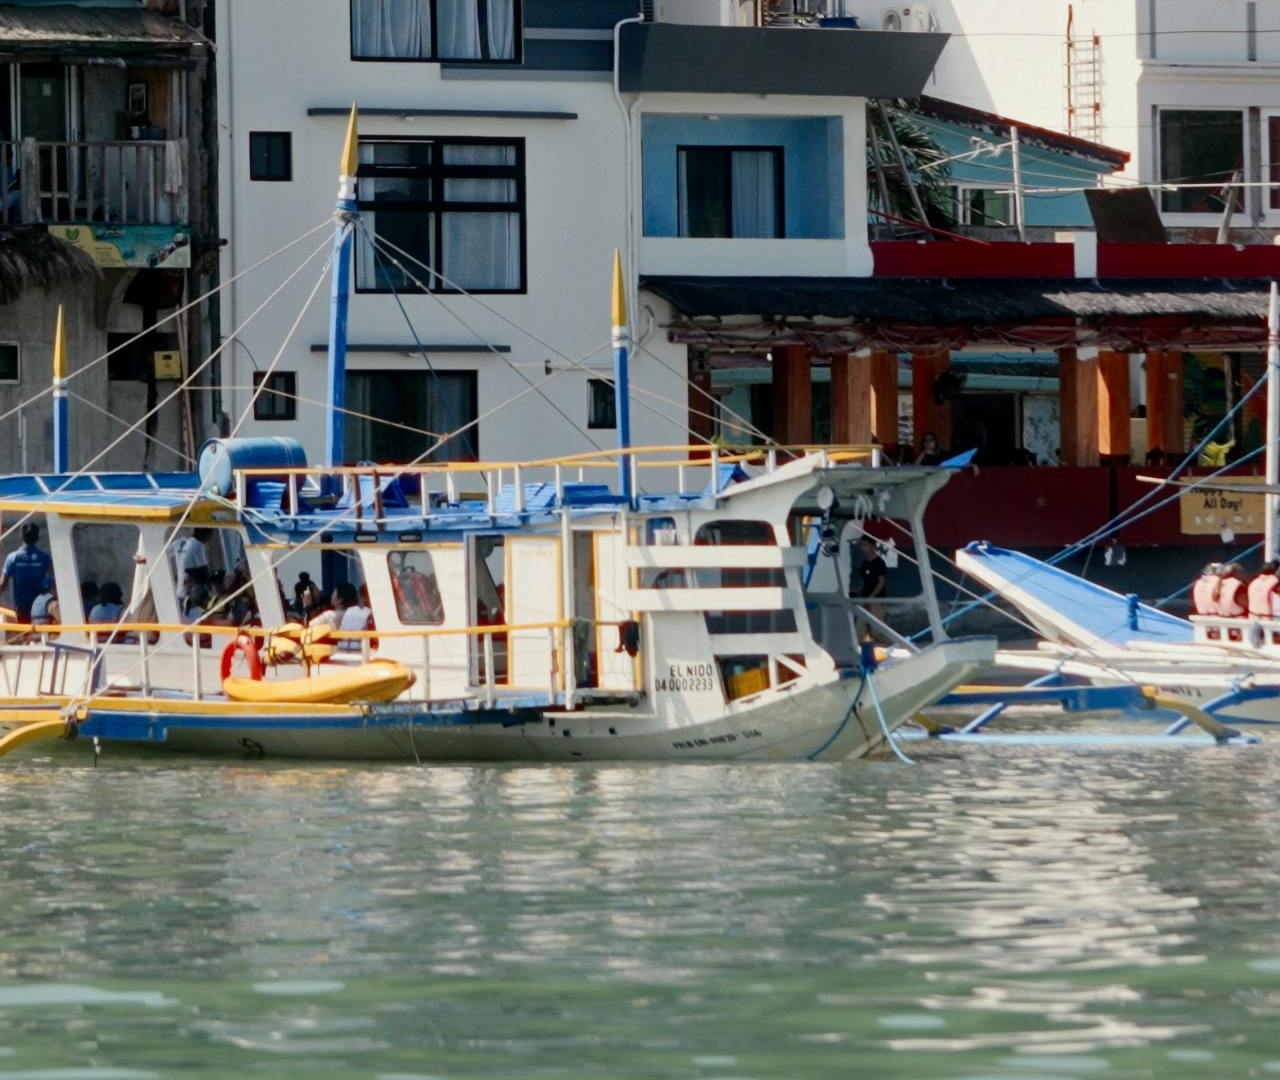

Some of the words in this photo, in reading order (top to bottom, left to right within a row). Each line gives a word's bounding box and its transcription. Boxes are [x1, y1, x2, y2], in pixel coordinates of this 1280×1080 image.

[1203, 498, 1217, 509] All
[1220, 497, 1242, 511] Day!
[670, 665, 682, 677] EL
